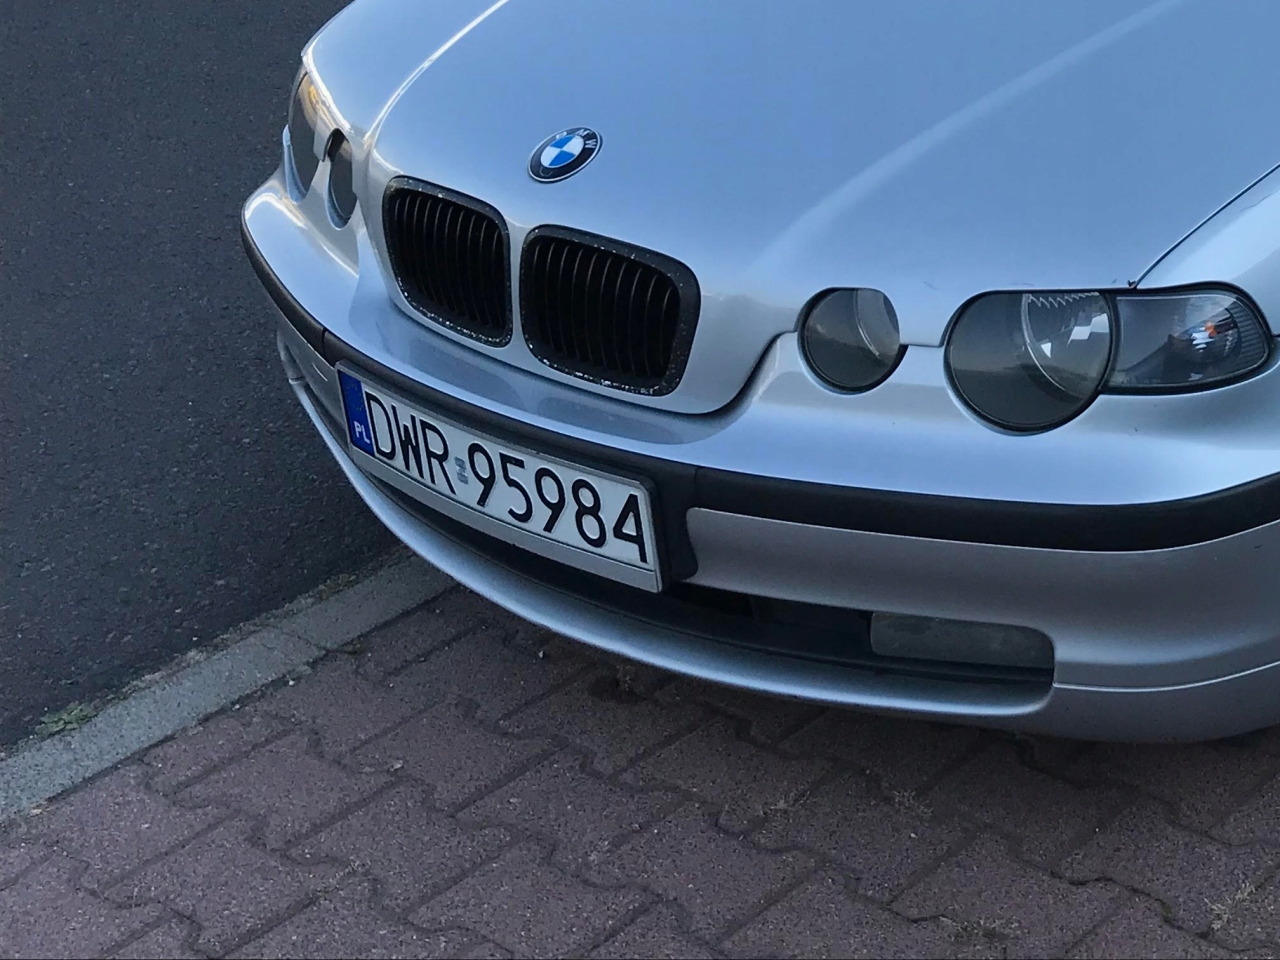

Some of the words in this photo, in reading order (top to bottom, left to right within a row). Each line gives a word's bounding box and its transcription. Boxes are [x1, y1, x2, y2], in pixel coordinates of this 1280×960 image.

[353, 419, 371, 445] PL
[364, 389, 457, 496] DWR
[467, 442, 649, 564] 95984
